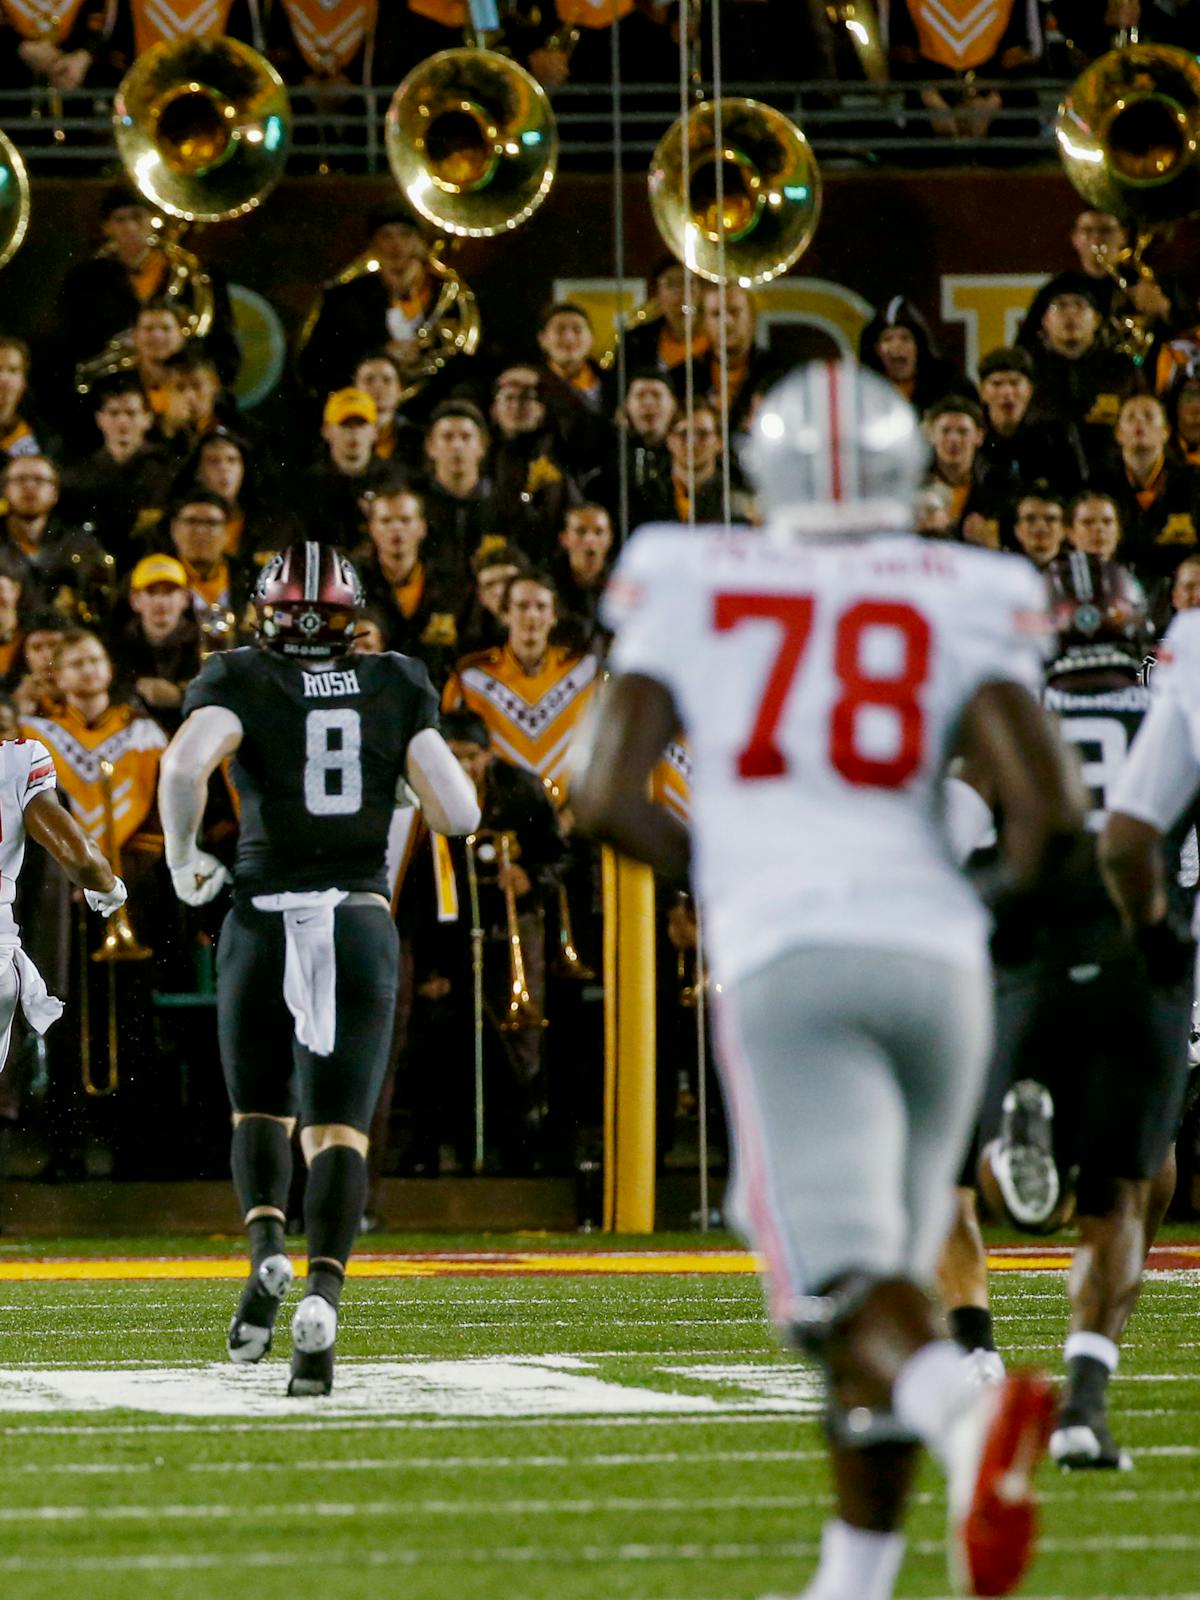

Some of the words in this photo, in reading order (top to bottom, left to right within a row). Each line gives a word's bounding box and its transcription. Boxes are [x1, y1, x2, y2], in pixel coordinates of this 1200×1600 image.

[302, 669, 360, 697] RUSH
[713, 590, 932, 790] 78
[304, 708, 362, 815] 8
